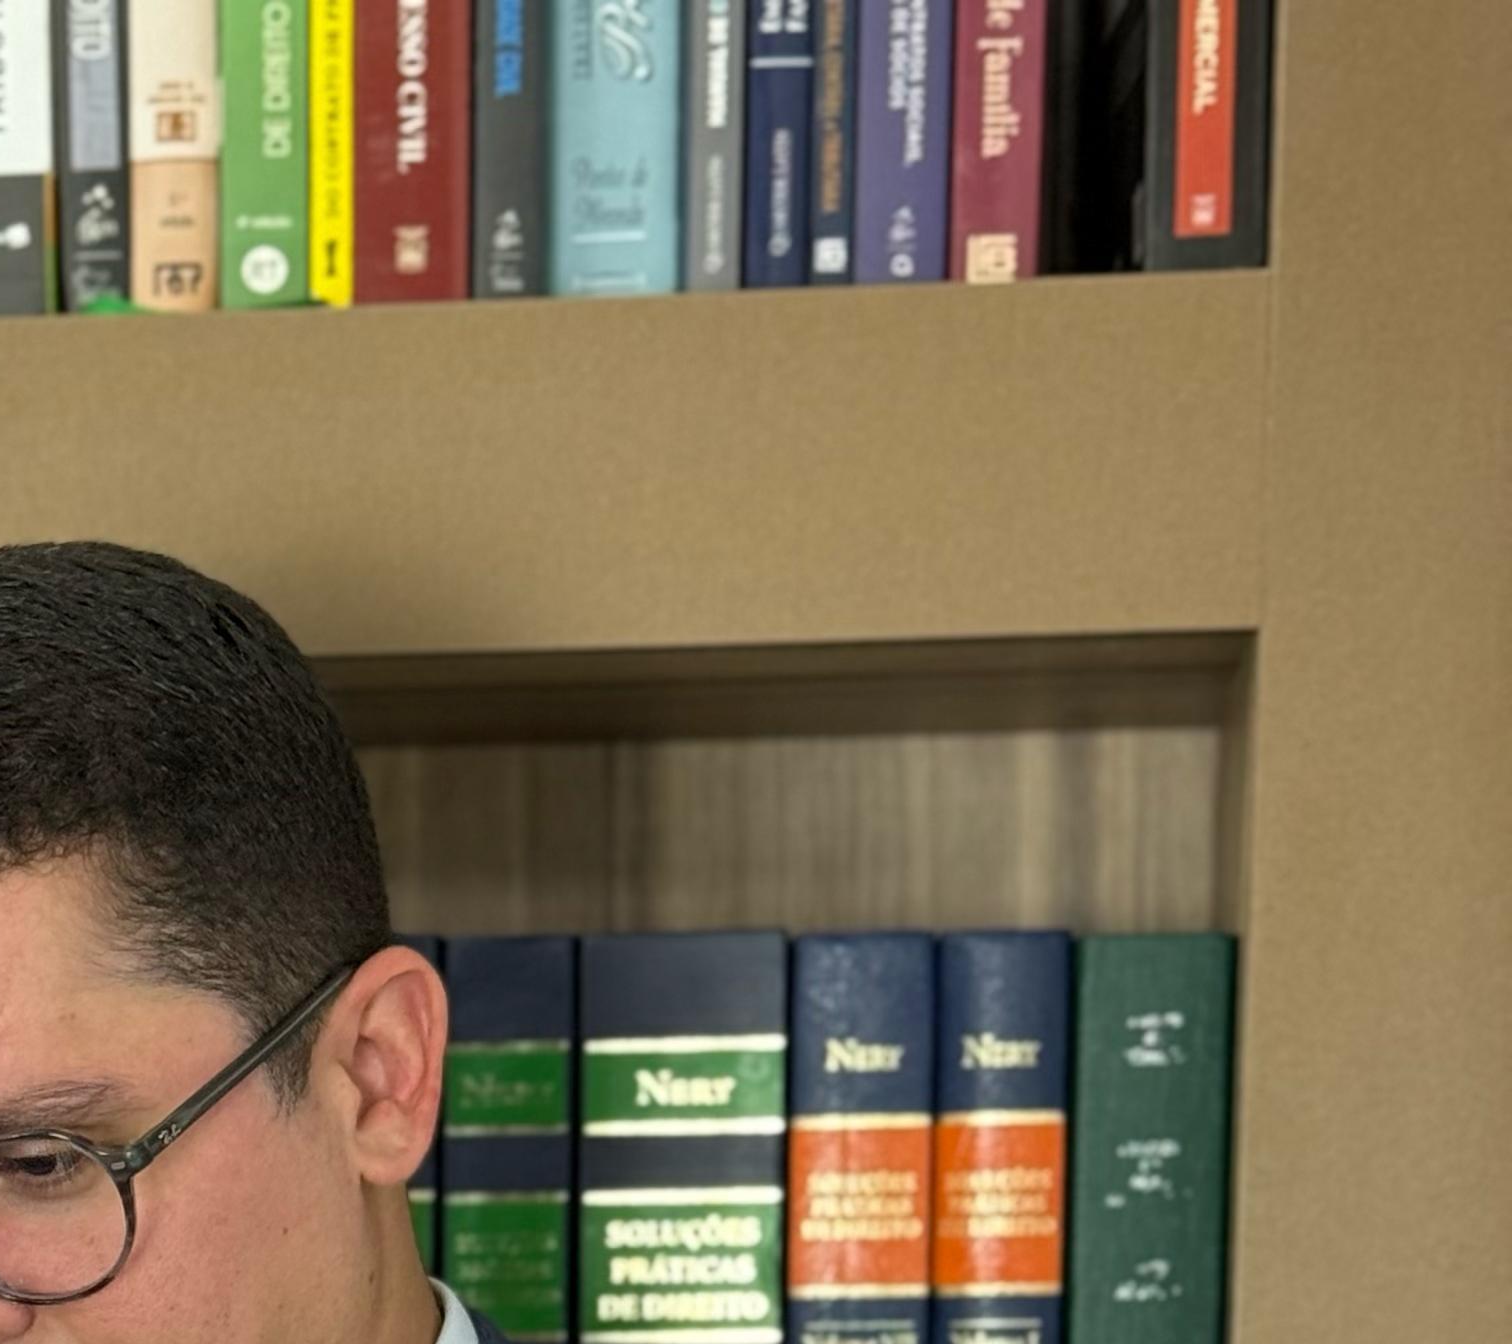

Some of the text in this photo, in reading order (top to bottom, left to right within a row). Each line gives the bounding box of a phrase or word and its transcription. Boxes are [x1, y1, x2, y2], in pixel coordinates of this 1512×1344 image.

[604, 1212, 763, 1252] SOLUÇÕES
[609, 1252, 757, 1286] PRÁTICAS
[597, 1290, 771, 1322] DE DIREITO
